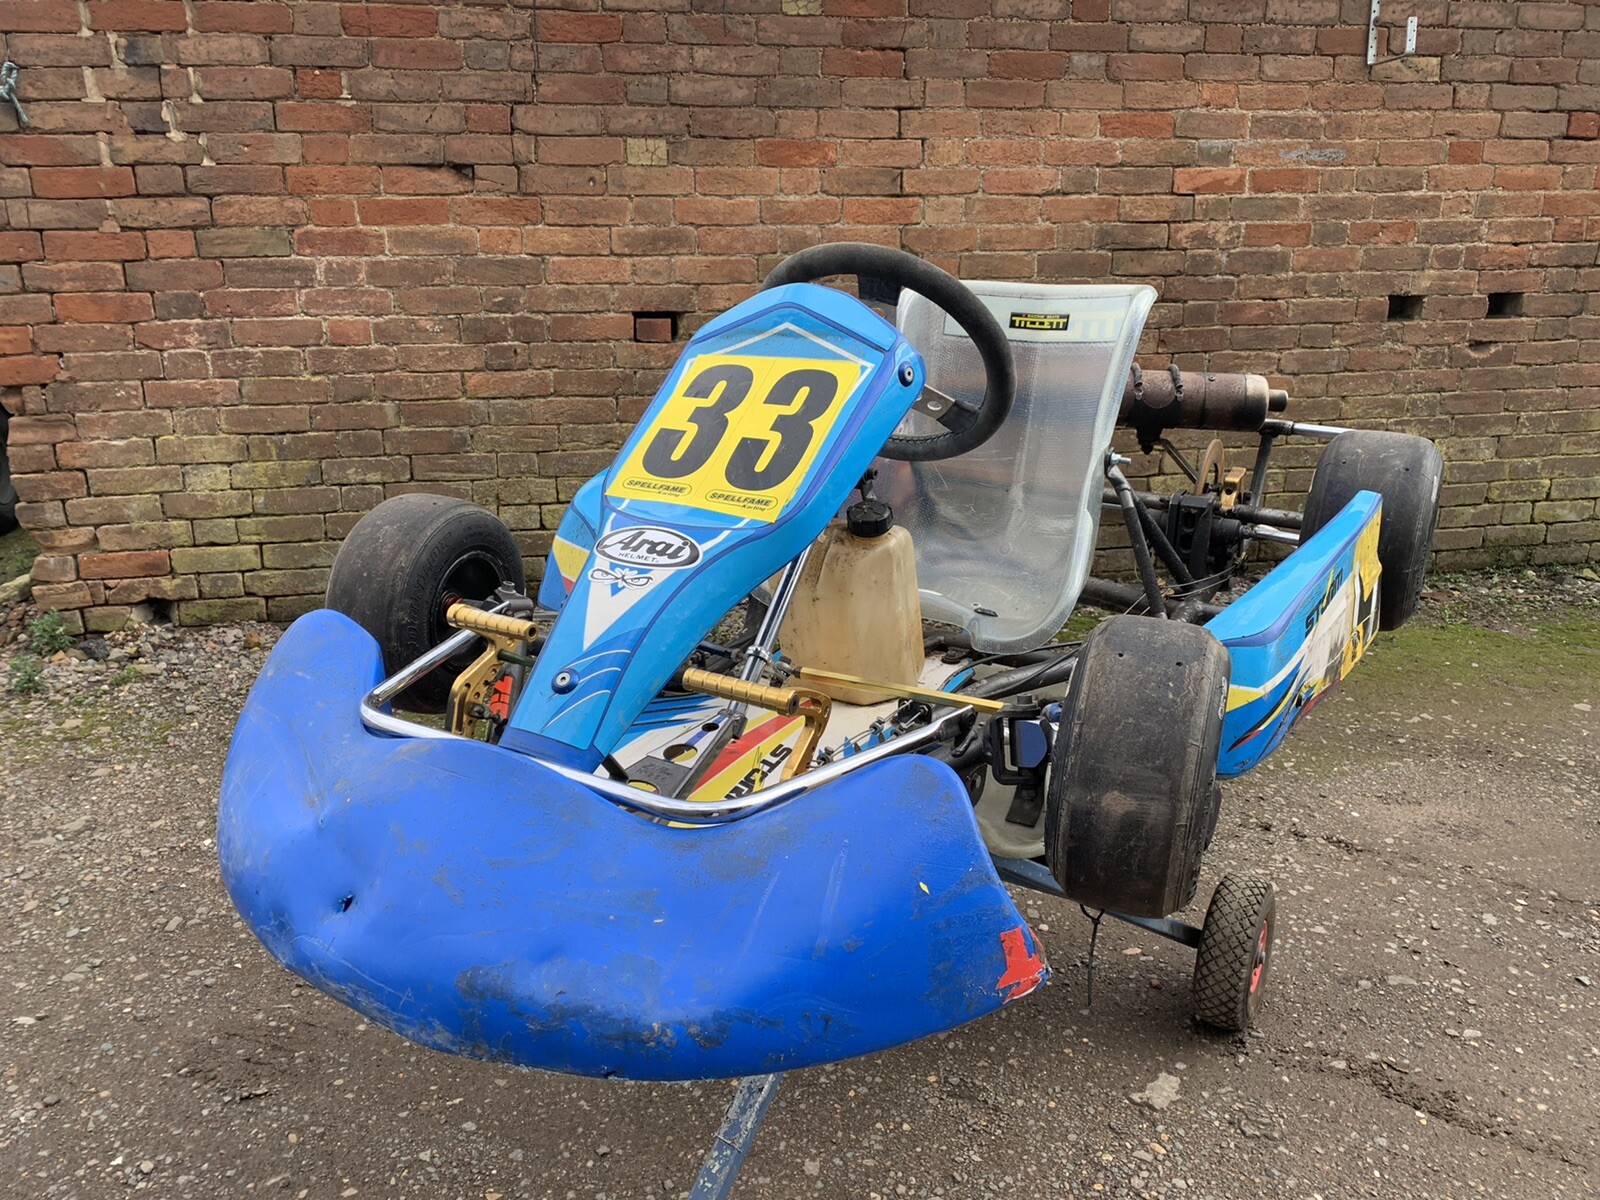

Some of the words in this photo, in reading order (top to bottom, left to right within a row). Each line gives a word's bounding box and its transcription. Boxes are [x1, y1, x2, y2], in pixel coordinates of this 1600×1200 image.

[642, 364, 839, 491] 33
[627, 479, 688, 493] SPELLFAME
[710, 492, 774, 507] SPELLFAME
[601, 530, 691, 560] Arai
[617, 552, 657, 564] HELMET
